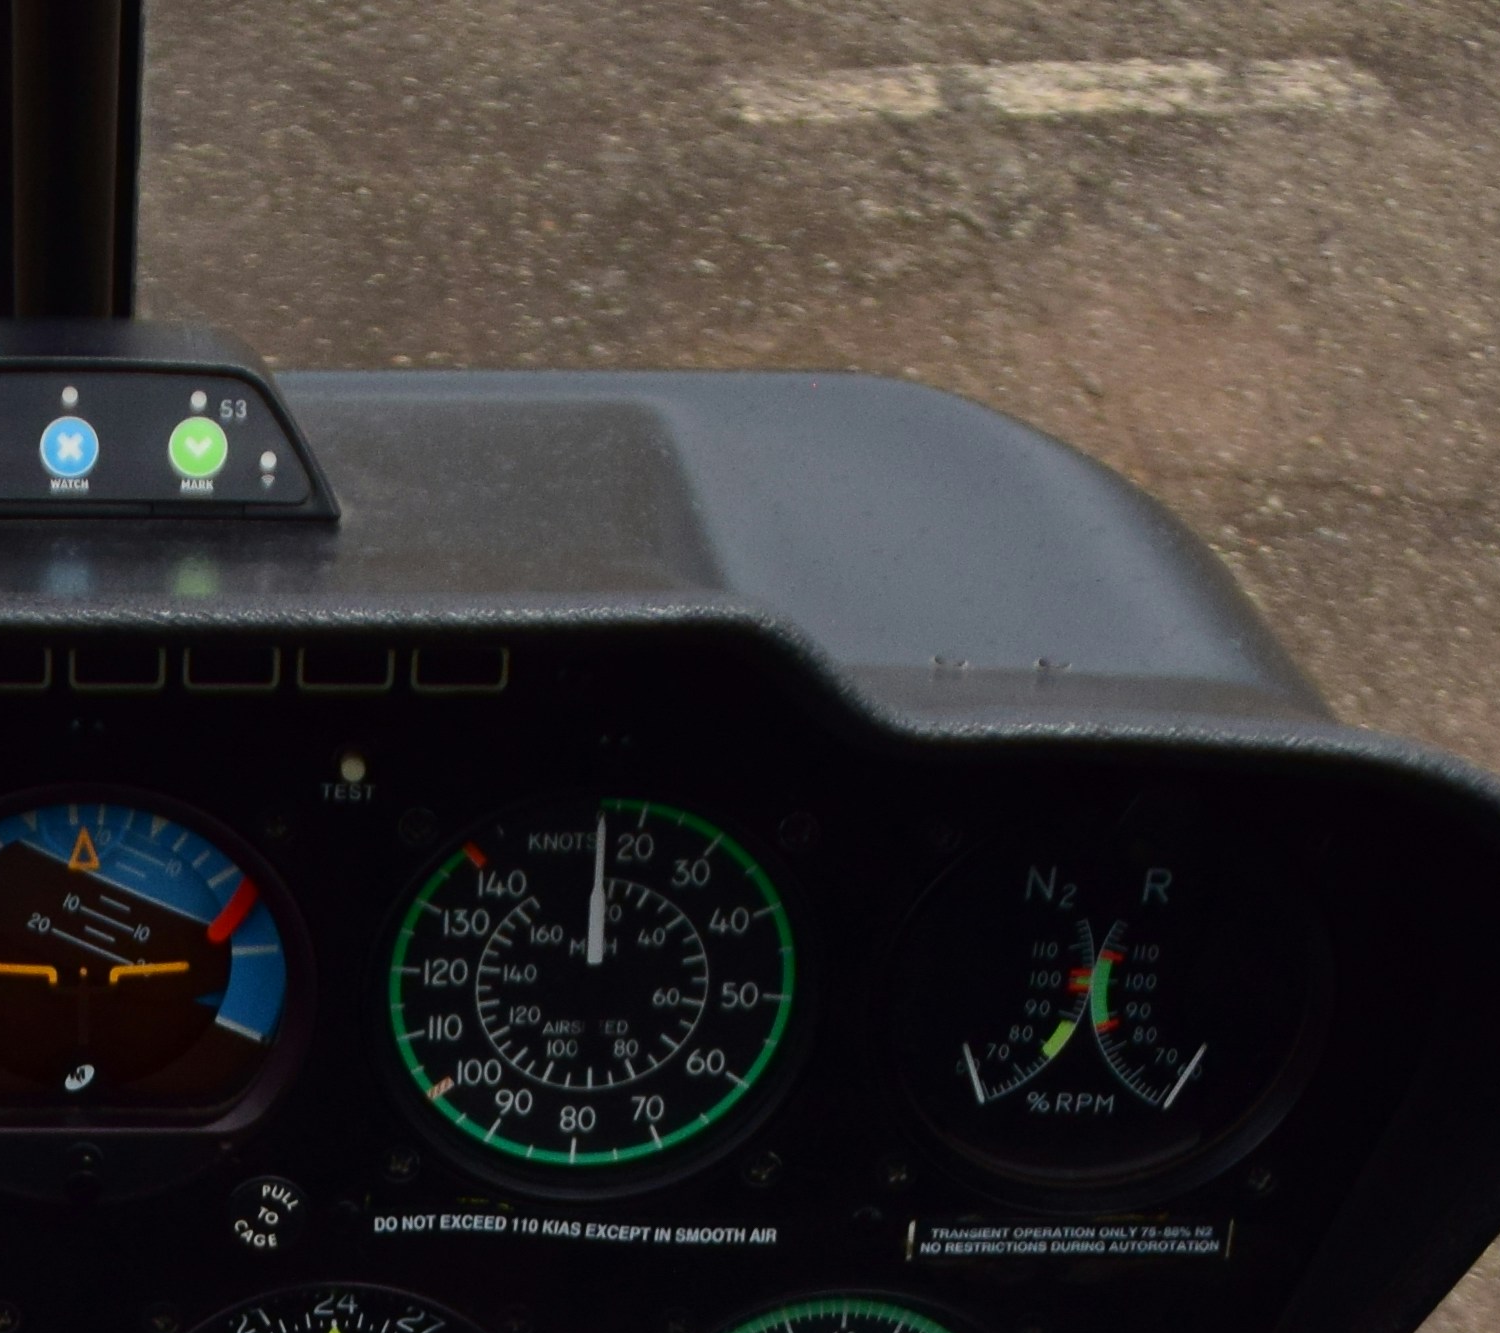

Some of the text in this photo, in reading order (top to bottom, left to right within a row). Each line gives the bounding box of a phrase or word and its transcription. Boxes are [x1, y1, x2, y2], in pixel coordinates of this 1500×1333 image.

[220, 400, 246, 418] S3
[50, 478, 89, 489] WATCH
[181, 478, 214, 489] MARK
[321, 783, 375, 800] TEST
[1142, 868, 1173, 903] R
[262, 1184, 299, 1211] PULL
[258, 1206, 279, 1225] TO
[234, 1219, 278, 1248] CAGE
[374, 1214, 777, 1244] DO NOT EXCEED 110 KIAS EXCEPT IN SMOOTH AIR
[920, 1240, 1219, 1253] NO RESTRICTIONS DURING AUTOROTATION
